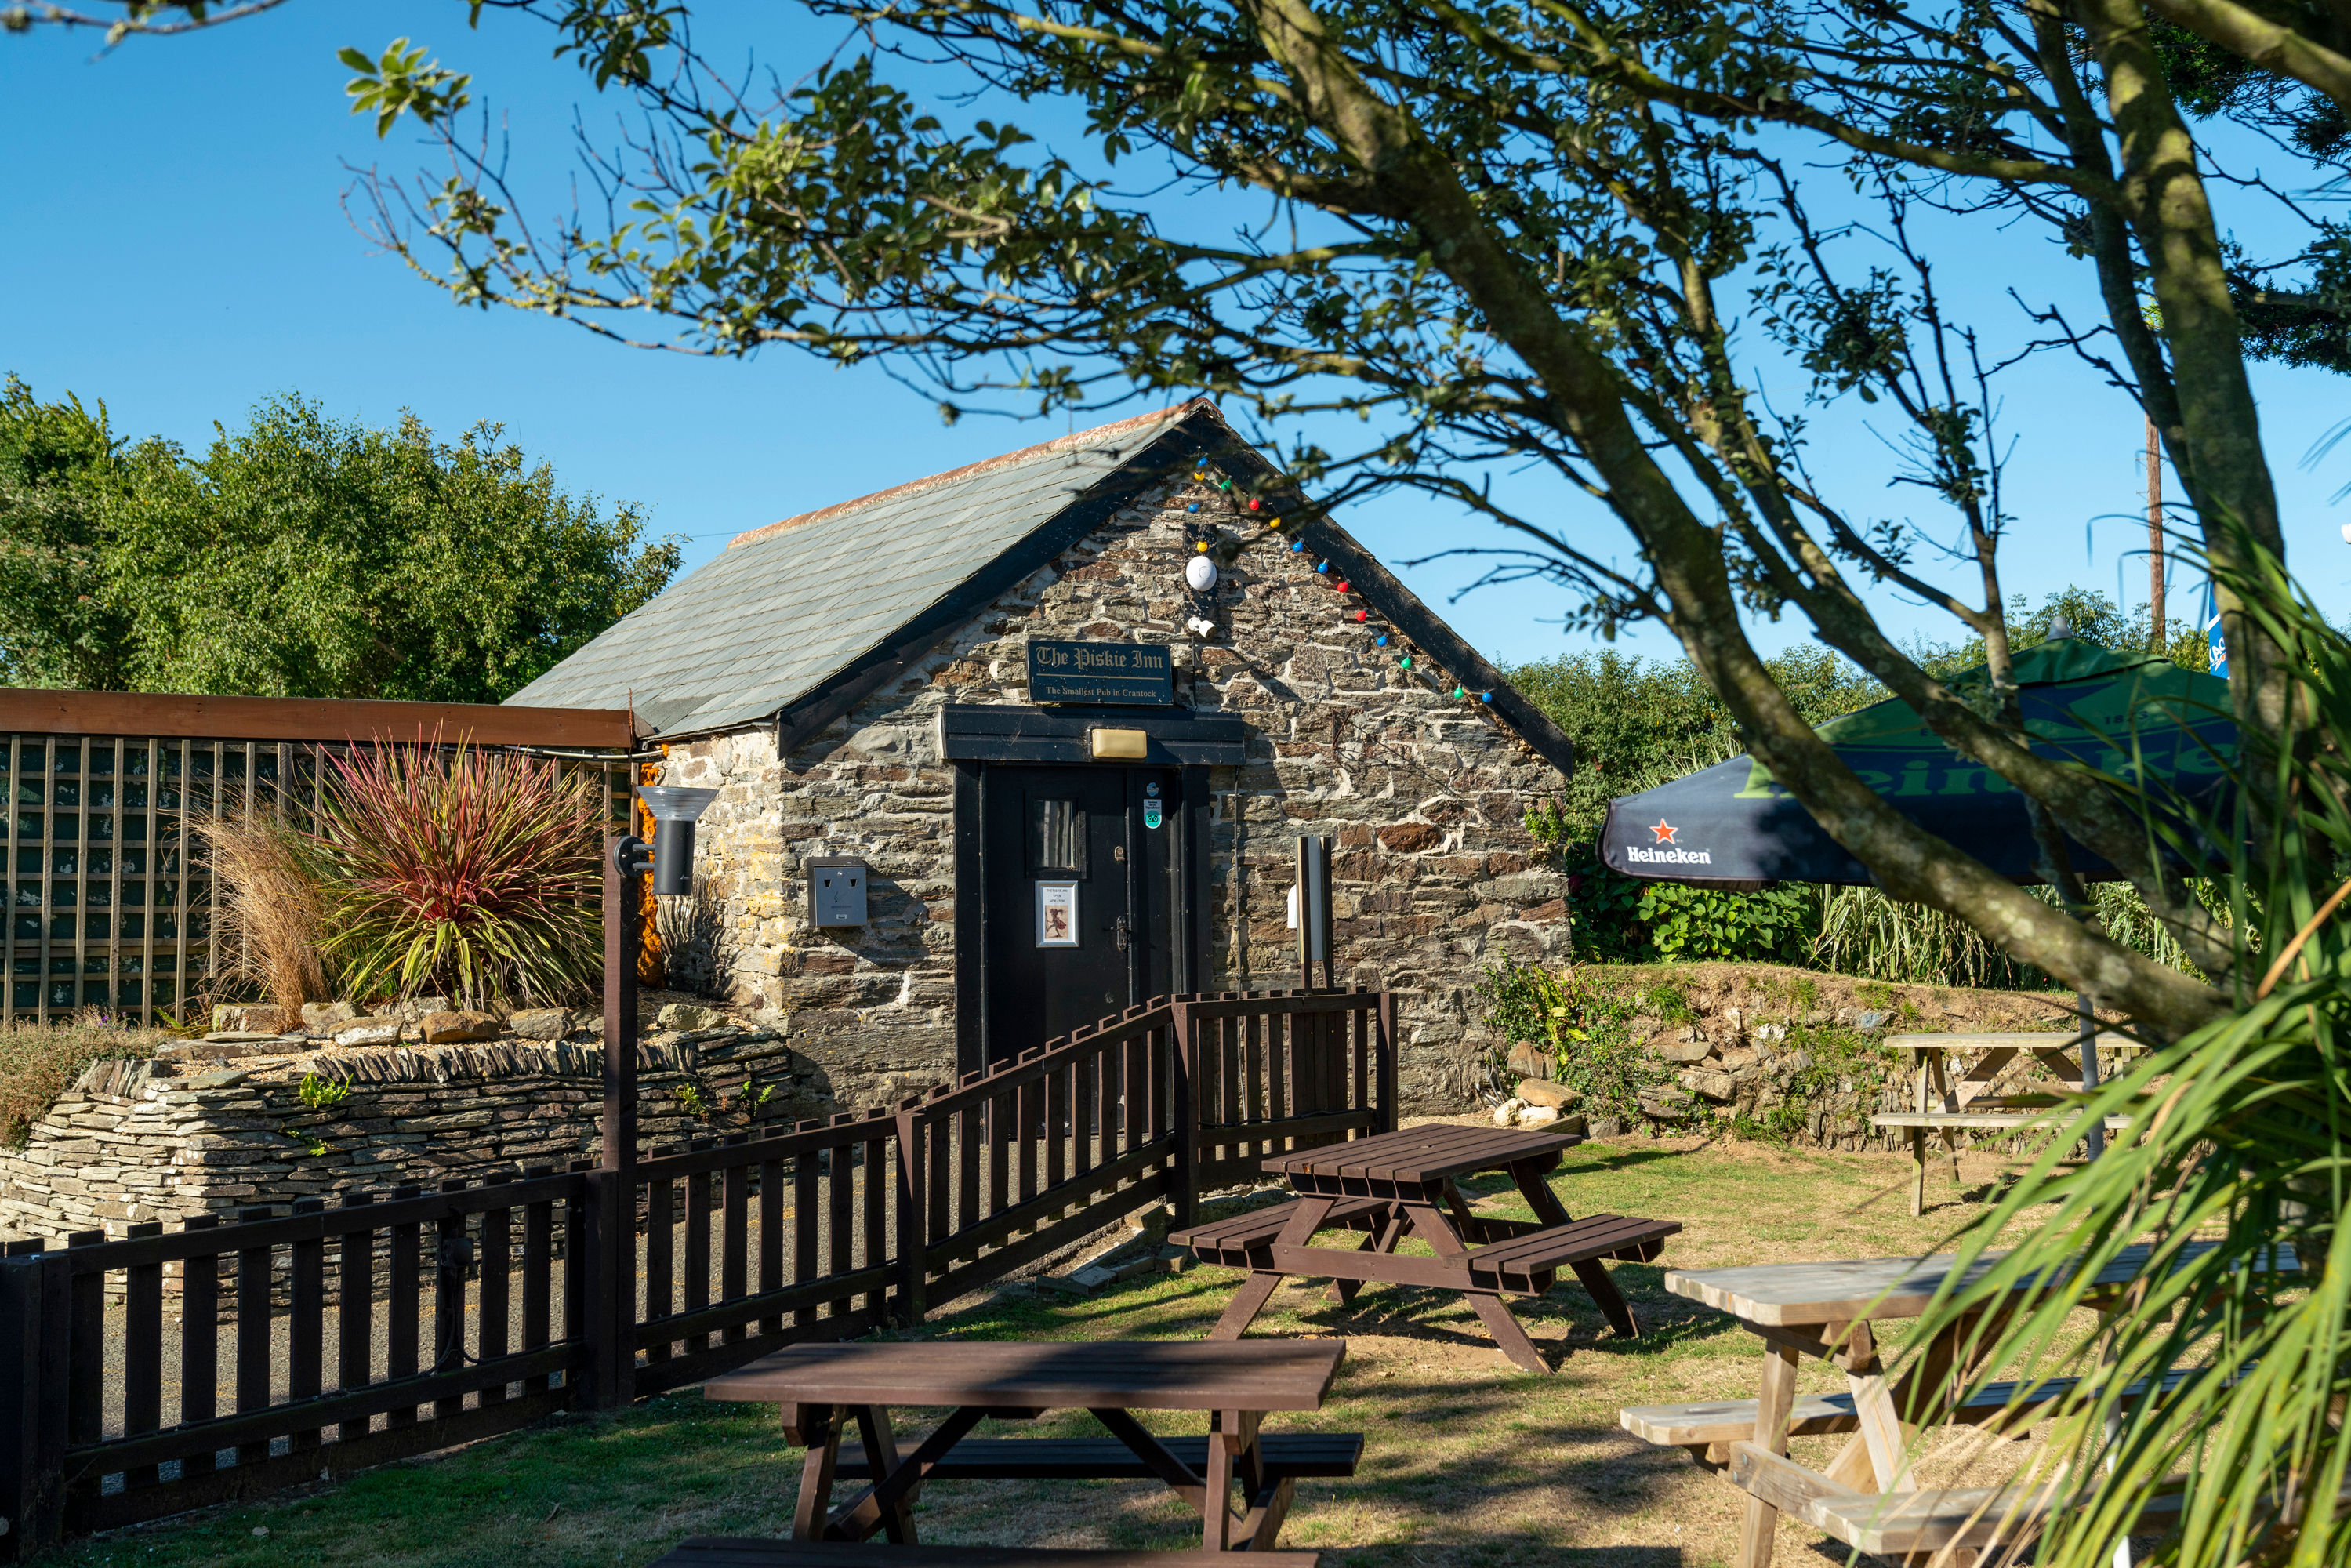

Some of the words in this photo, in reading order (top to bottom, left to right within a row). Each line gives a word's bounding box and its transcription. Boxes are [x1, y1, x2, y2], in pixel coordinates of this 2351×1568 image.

[1036, 646, 1068, 668] The
[1073, 648, 1127, 669] Piskie
[1131, 650, 1163, 669] Inn
[1046, 686, 1061, 695] The
[1062, 687, 1094, 695] Smallest
[1627, 846, 1712, 865] Heineken
